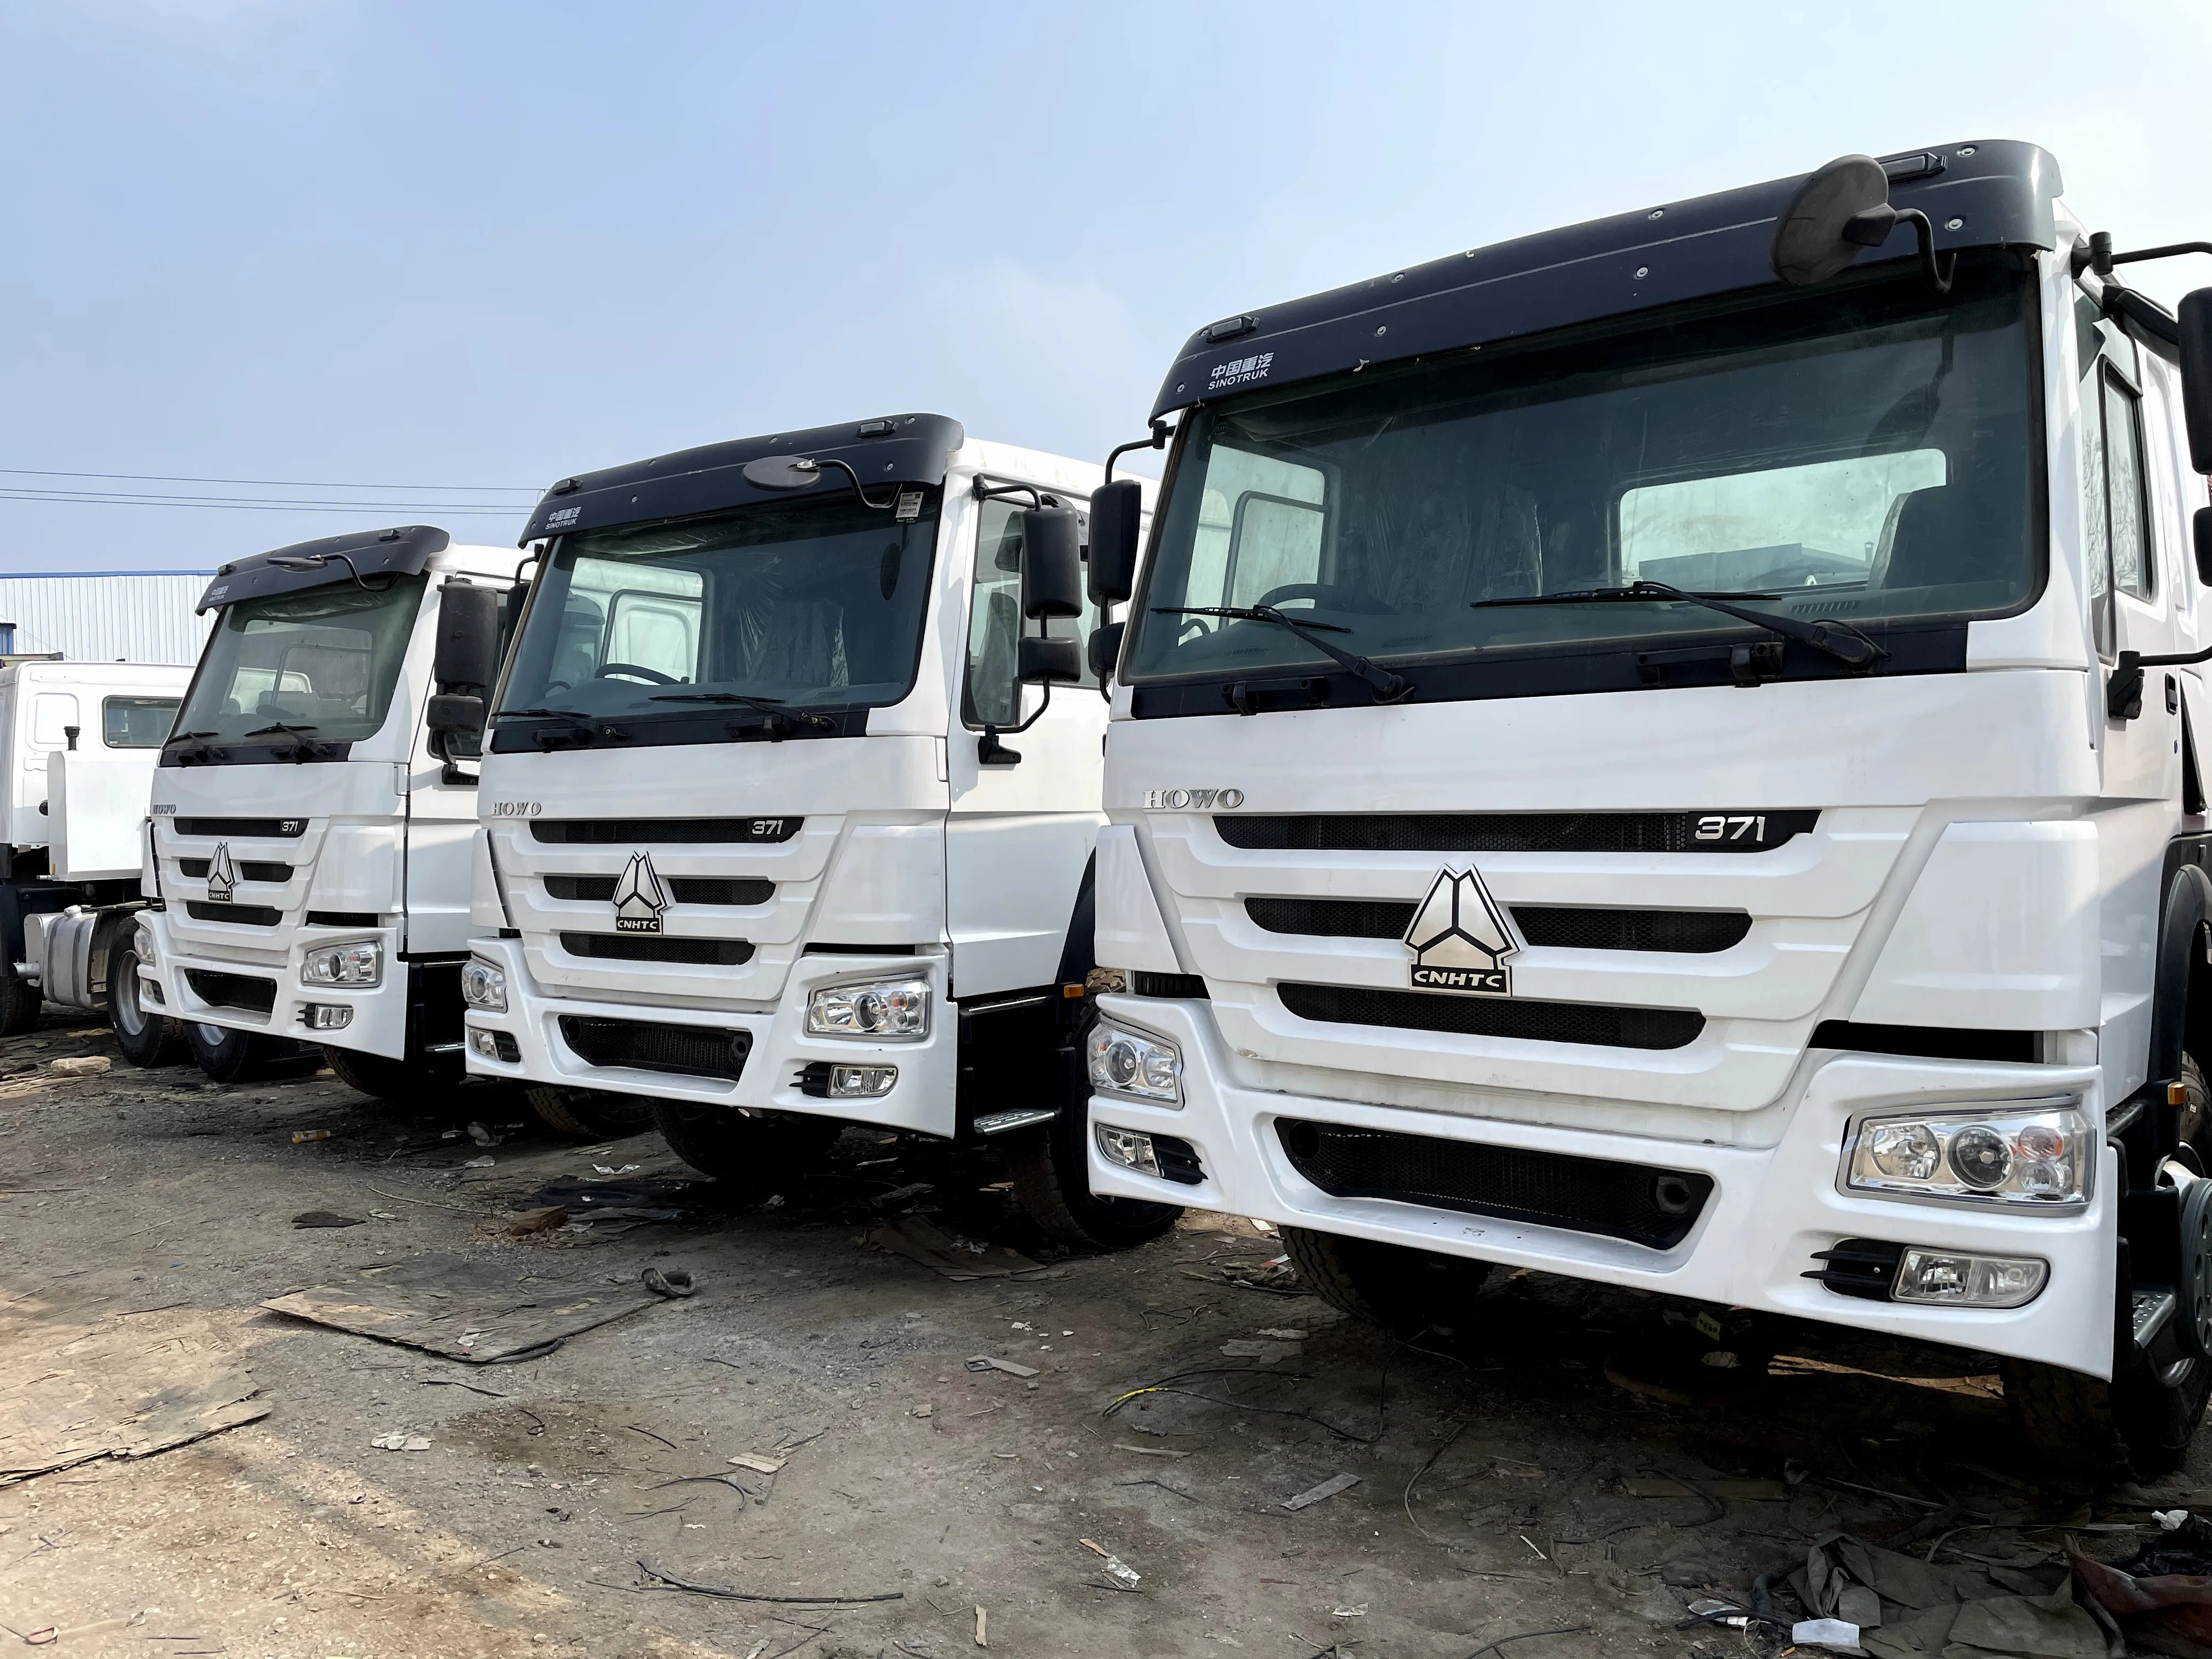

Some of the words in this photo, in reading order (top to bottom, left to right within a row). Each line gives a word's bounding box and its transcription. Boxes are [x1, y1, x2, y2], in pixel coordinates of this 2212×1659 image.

[1211, 352, 1274, 379] 中国重汽
[1208, 368, 1268, 390] SINOTRUK
[545, 518, 577, 530] SINOTRUK
[1142, 789, 1244, 808] HOWO
[491, 802, 541, 816] HOWO
[282, 821, 298, 832] 371
[752, 820, 783, 834] 371
[1695, 816, 1765, 842] 371
[617, 919, 658, 929] CNHTC
[1414, 970, 1502, 987] CNHTC
